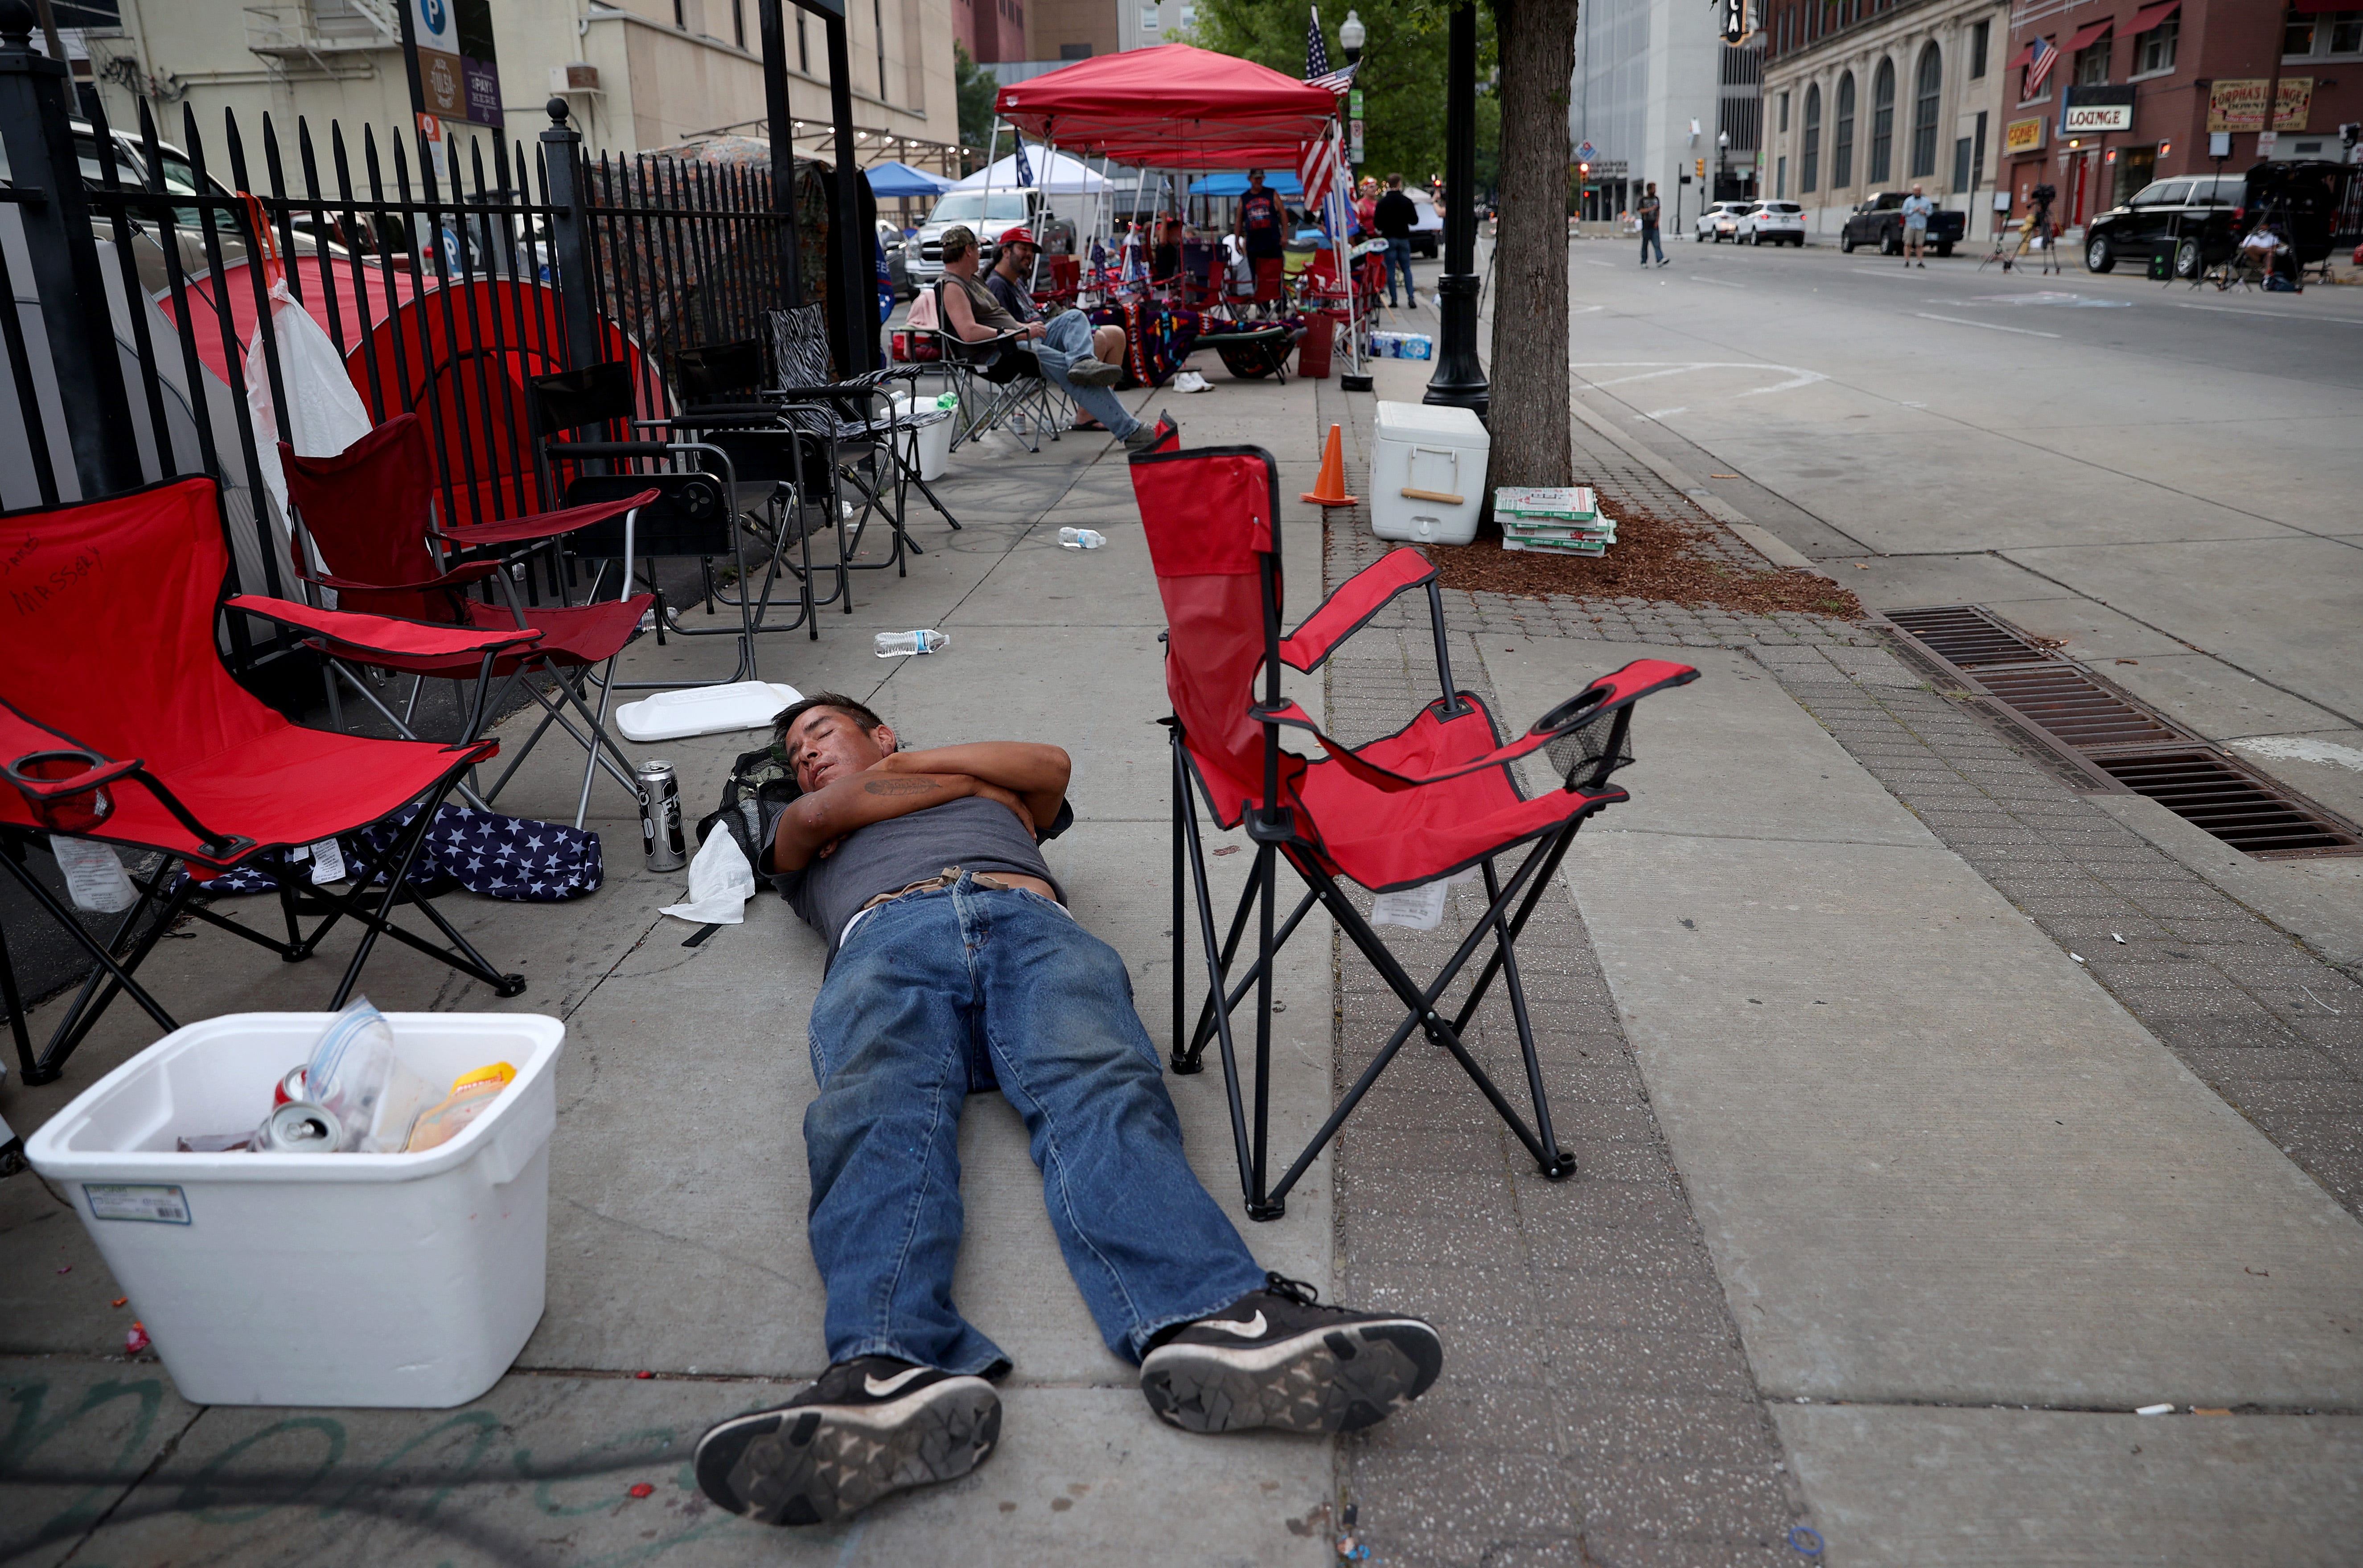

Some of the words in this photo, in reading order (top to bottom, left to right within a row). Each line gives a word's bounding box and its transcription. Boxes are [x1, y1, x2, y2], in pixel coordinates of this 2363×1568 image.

[475, 78, 489, 94] PAY
[2263, 86, 2302, 104] LUNGE
[2070, 111, 2121, 125] LOUNGE
